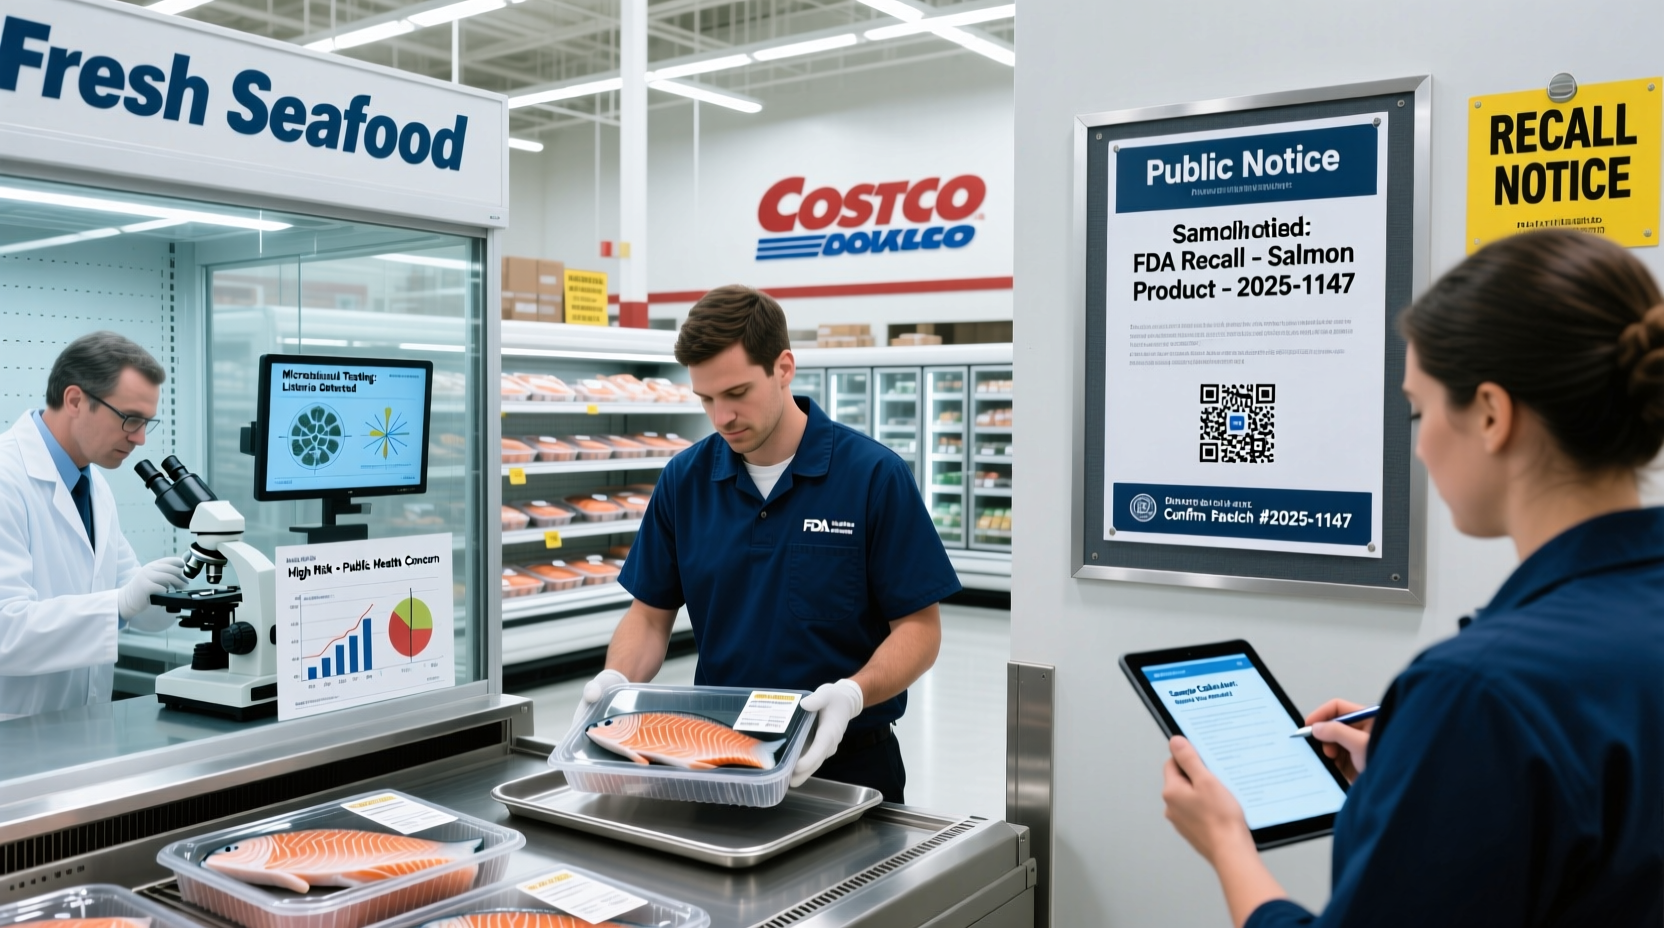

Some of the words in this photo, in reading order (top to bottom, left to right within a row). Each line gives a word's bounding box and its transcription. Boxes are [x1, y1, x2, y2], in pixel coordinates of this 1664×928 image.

[0, 15, 210, 126] Fresh
[226, 68, 469, 171] Seafood
[1490, 103, 1637, 155] RECALL
[1146, 152, 1234, 186] Public
[1242, 144, 1341, 178] Notice
[1495, 156, 1631, 206] NOTICE
[1133, 251, 1176, 273] FDA
[1181, 247, 1245, 271] Recall
[1267, 243, 1354, 267] Salmon
[1133, 279, 1216, 301] Product
[1237, 273, 1356, 297] 2025-1147
[803, 518, 830, 533] FDA
[1259, 509, 1352, 528] #2025-1147
